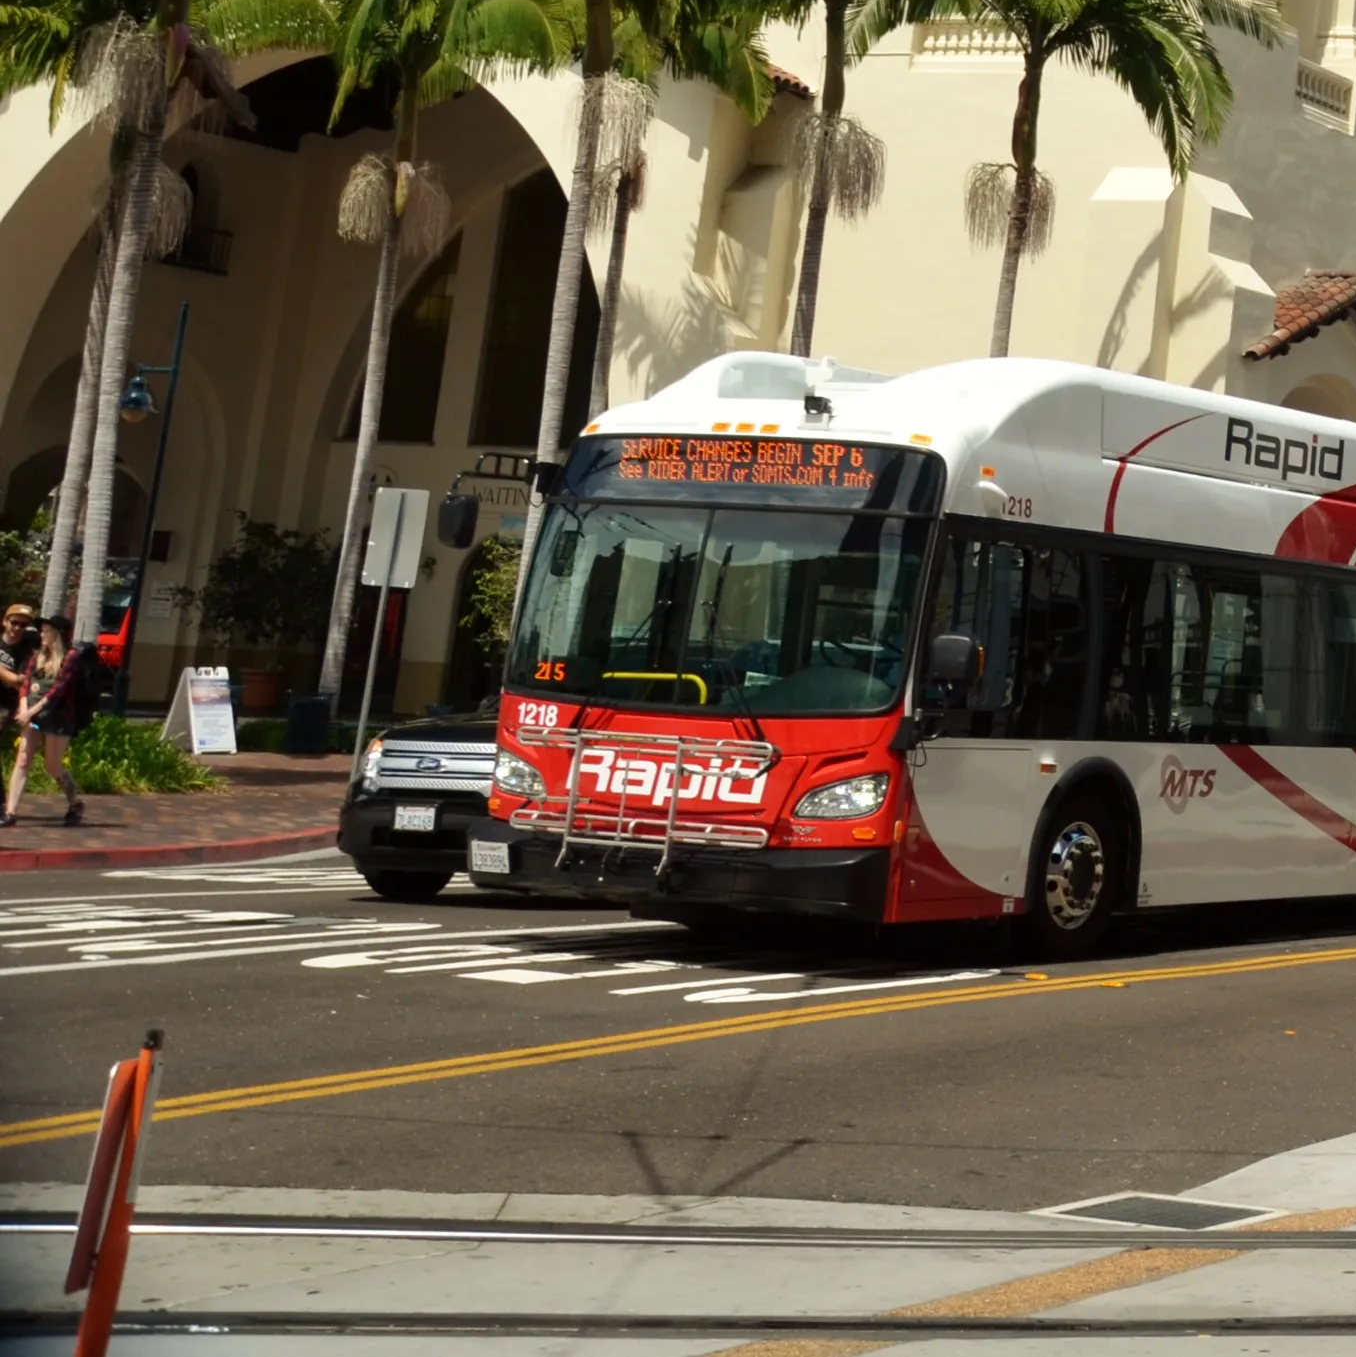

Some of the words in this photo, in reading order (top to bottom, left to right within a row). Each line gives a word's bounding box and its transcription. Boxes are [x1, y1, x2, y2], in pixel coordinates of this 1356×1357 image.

[621, 438, 682, 461] SERVICE
[687, 439, 752, 463] CHANGES
[757, 441, 802, 465] BEGIN
[812, 444, 846, 467] SEP
[850, 447, 864, 467] 6
[1224, 417, 1345, 481] Rapid
[619, 459, 643, 479] See
[648, 461, 687, 481] RIDER
[692, 463, 731, 483] ALERT
[732, 468, 749, 483] or
[1002, 496, 1032, 519] 1218
[534, 662, 566, 681] 215
[518, 702, 558, 727] 1218
[565, 749, 768, 806] Rapid
[1159, 769, 1217, 798] MTS
